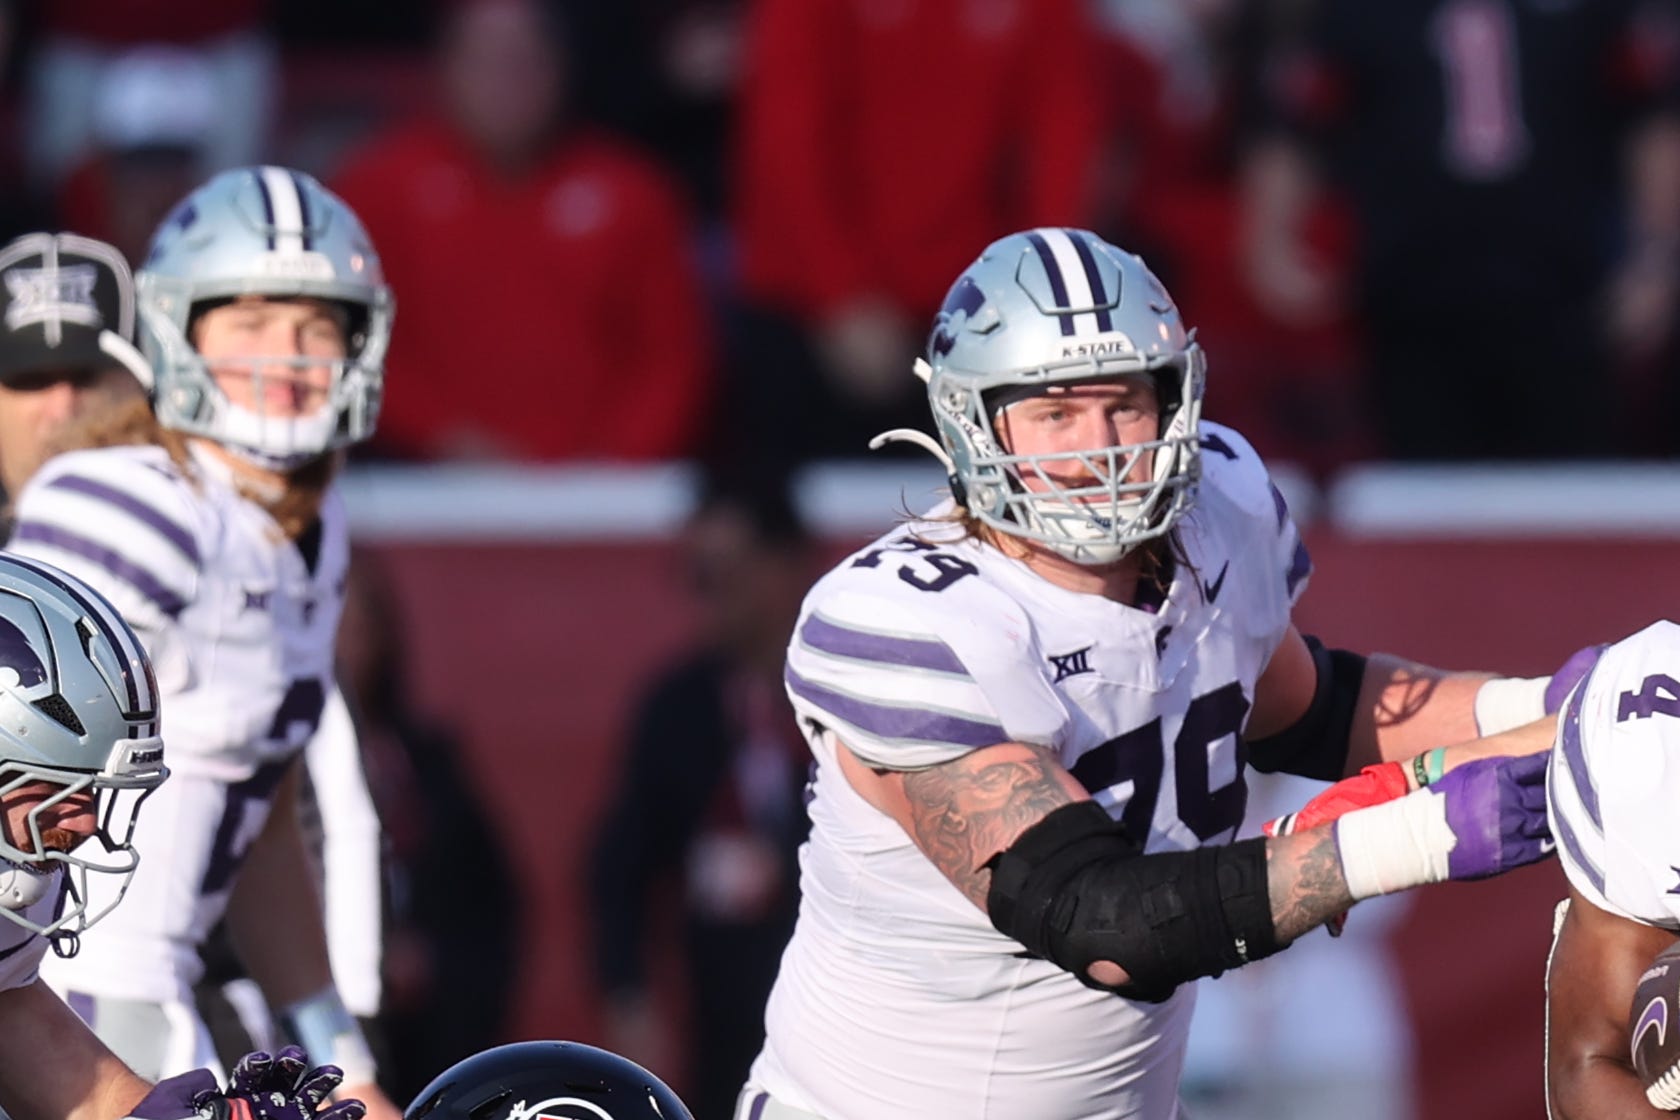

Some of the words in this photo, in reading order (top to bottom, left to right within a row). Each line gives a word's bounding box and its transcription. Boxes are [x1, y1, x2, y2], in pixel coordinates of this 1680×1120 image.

[851, 537, 980, 593] 79
[1048, 645, 1096, 684] XII
[1069, 680, 1252, 856] 79
